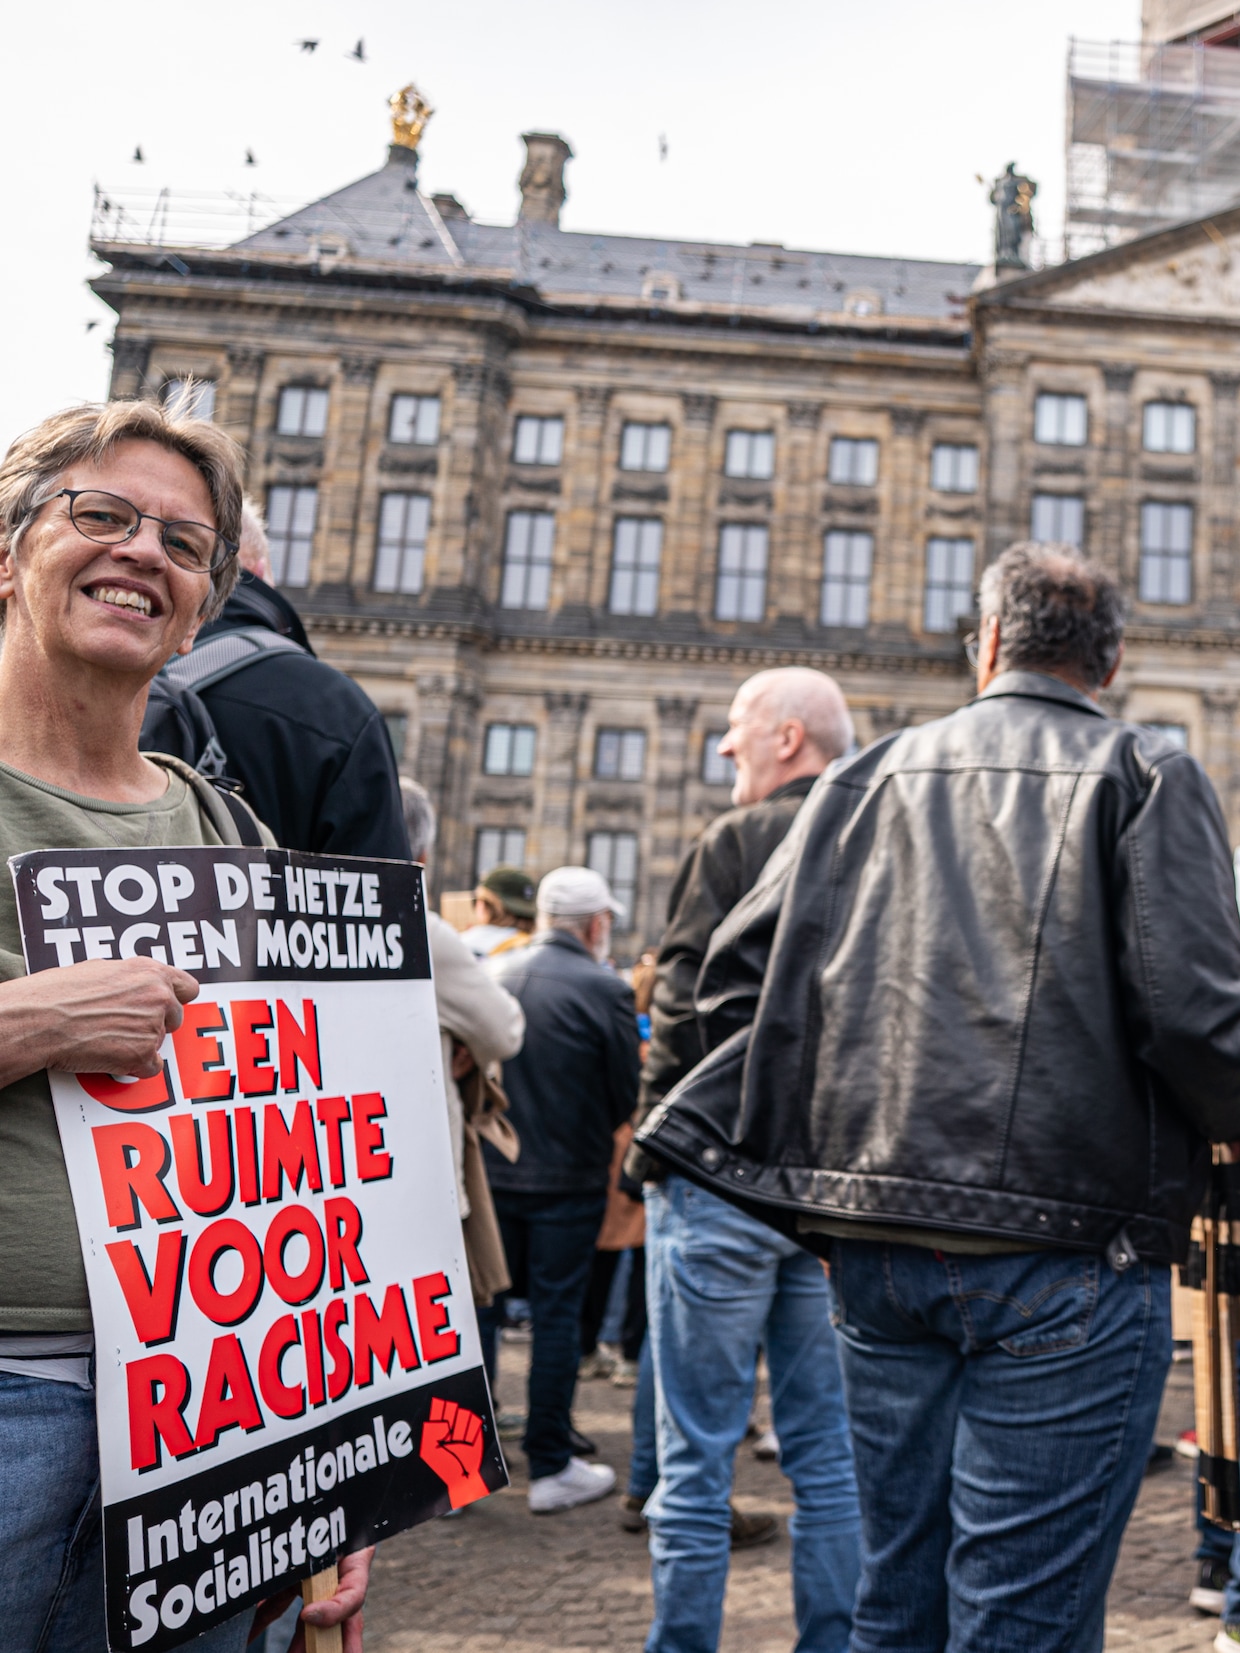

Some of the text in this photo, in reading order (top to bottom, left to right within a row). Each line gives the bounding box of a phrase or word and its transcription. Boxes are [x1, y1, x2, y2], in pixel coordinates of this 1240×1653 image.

[37, 863, 383, 921] STOP DE HETZE
[44, 918, 404, 970] TEGEN MOSLIMS
[91, 1092, 394, 1233] RUIMTE
[105, 1197, 371, 1349] VOOR
[126, 1271, 461, 1475] RACISME
[127, 1415, 413, 1576] Internationale
[131, 1505, 347, 1648] Socialisten
